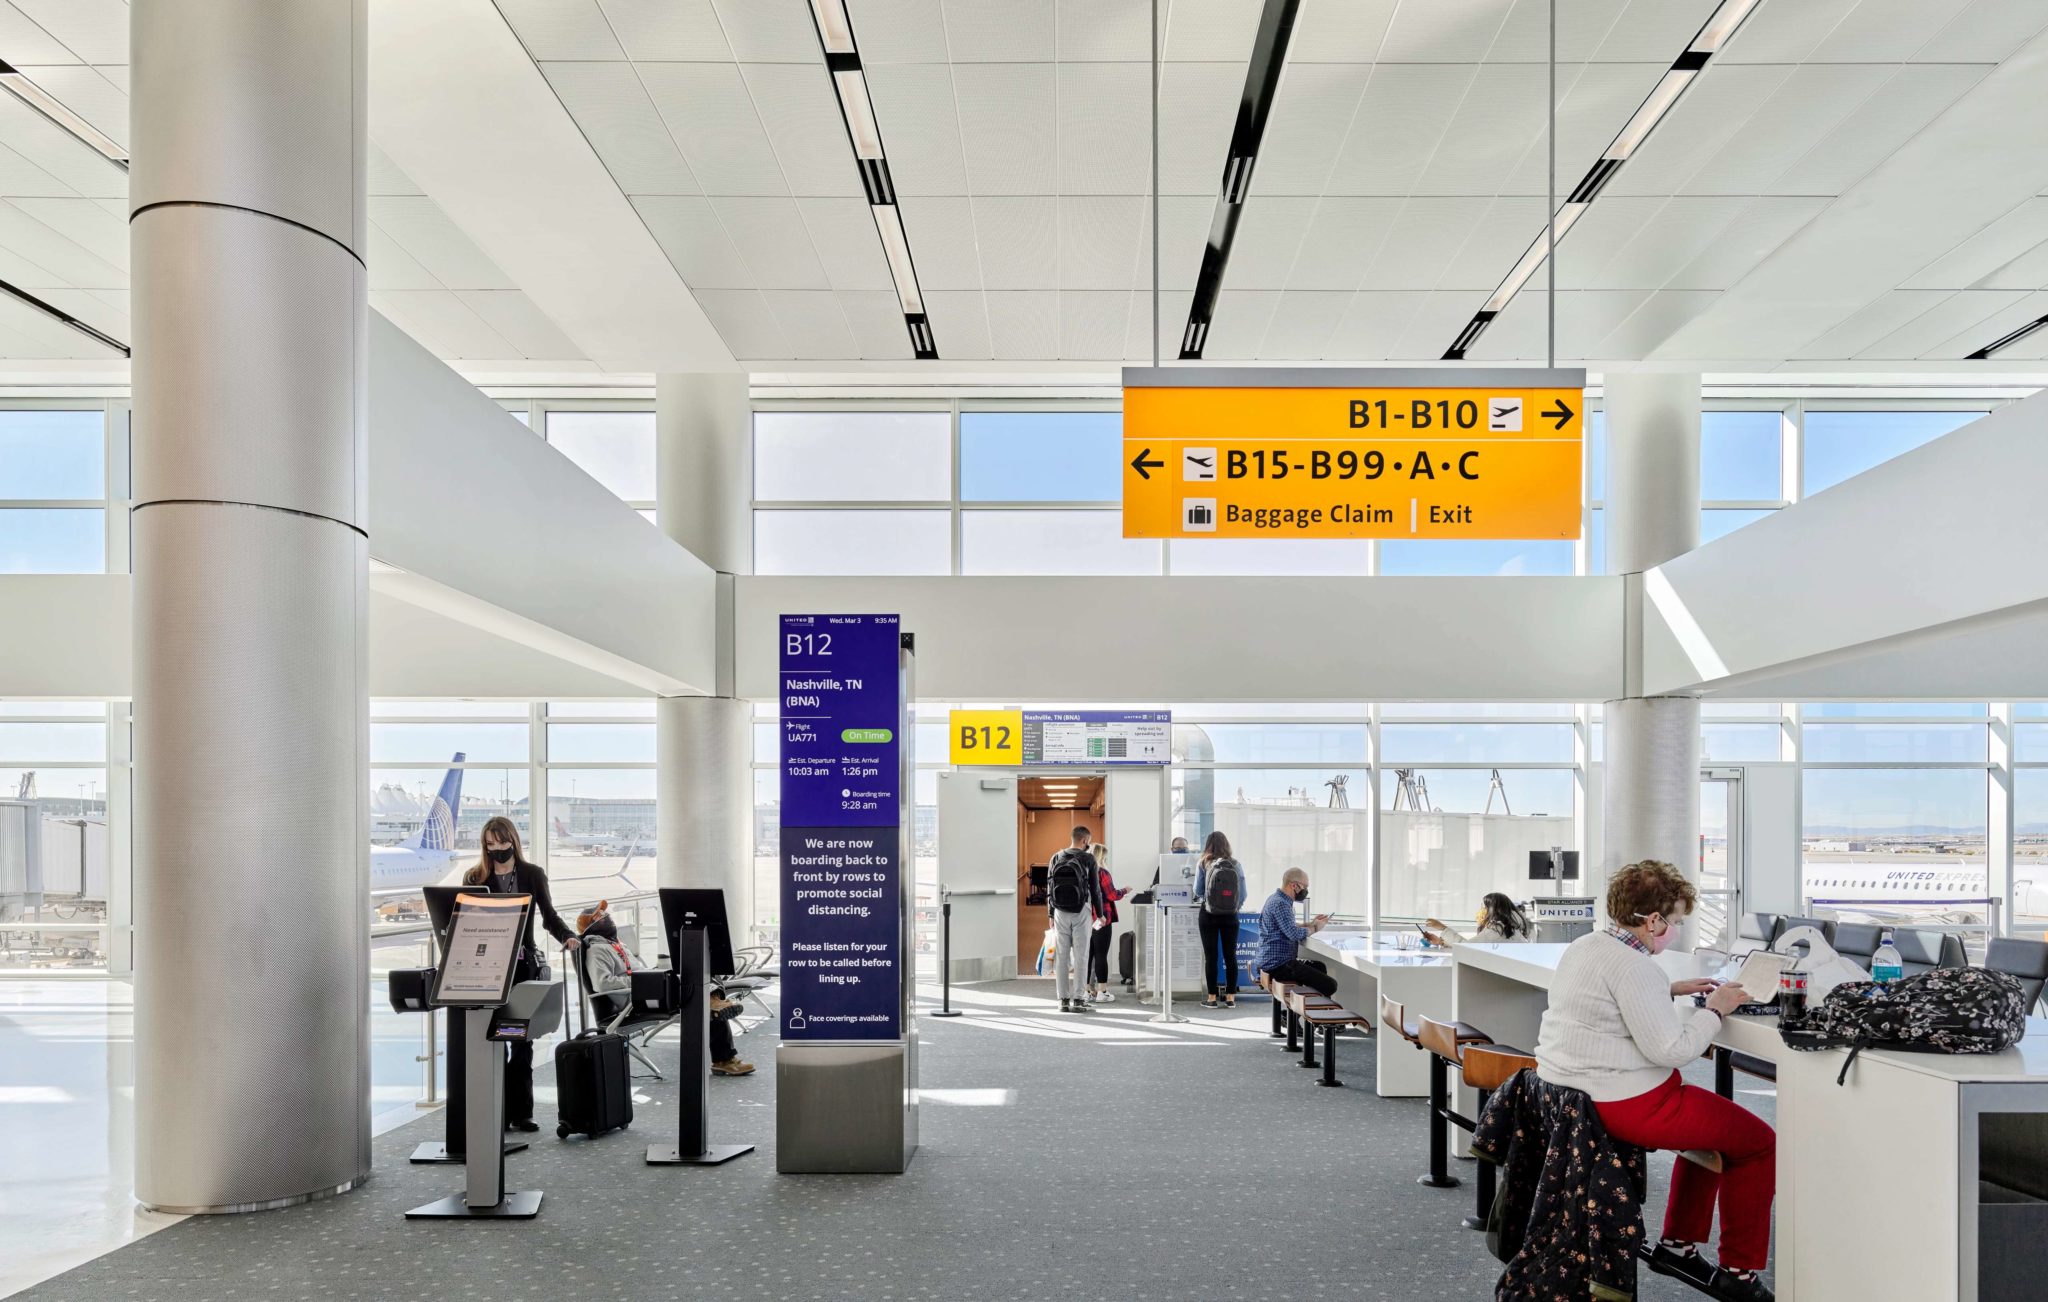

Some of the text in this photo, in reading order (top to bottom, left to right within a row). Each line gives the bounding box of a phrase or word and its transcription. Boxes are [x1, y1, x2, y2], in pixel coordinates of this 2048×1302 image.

[1349, 400, 1478, 430] B1-B10
[1227, 503, 1393, 529] Baggage Claim
[1430, 505, 1472, 524] Exit
[787, 633, 832, 655] B12
[786, 679, 862, 691] Nashville, TN
[786, 695, 820, 709] (BNA)
[795, 723, 811, 731] Flight
[788, 733, 817, 742] UA771
[849, 731, 885, 739] On Time
[961, 726, 1011, 750] B12
[807, 757, 836, 765] Departure
[788, 767, 812, 776] 10:03
[842, 767, 878, 778] 1:26 pm
[853, 791, 877, 799] Boarding
[841, 800, 877, 810] 9:28 am
[804, 838, 874, 849] We are now
[791, 854, 888, 868] boarding back to
[793, 871, 886, 884] front by rows to
[1887, 871, 1986, 881] UNITED EXPRES
[797, 887, 883, 901] promote social
[808, 904, 871, 917] distancing.
[792, 942, 888, 953] Please listen for your
[807, 958, 818, 967] to
[819, 958, 832, 967] be
[833, 957, 860, 967] called
[861, 957, 892, 967] before
[818, 973, 861, 985] lining up.
[808, 1014, 890, 1024] Face coverings available
